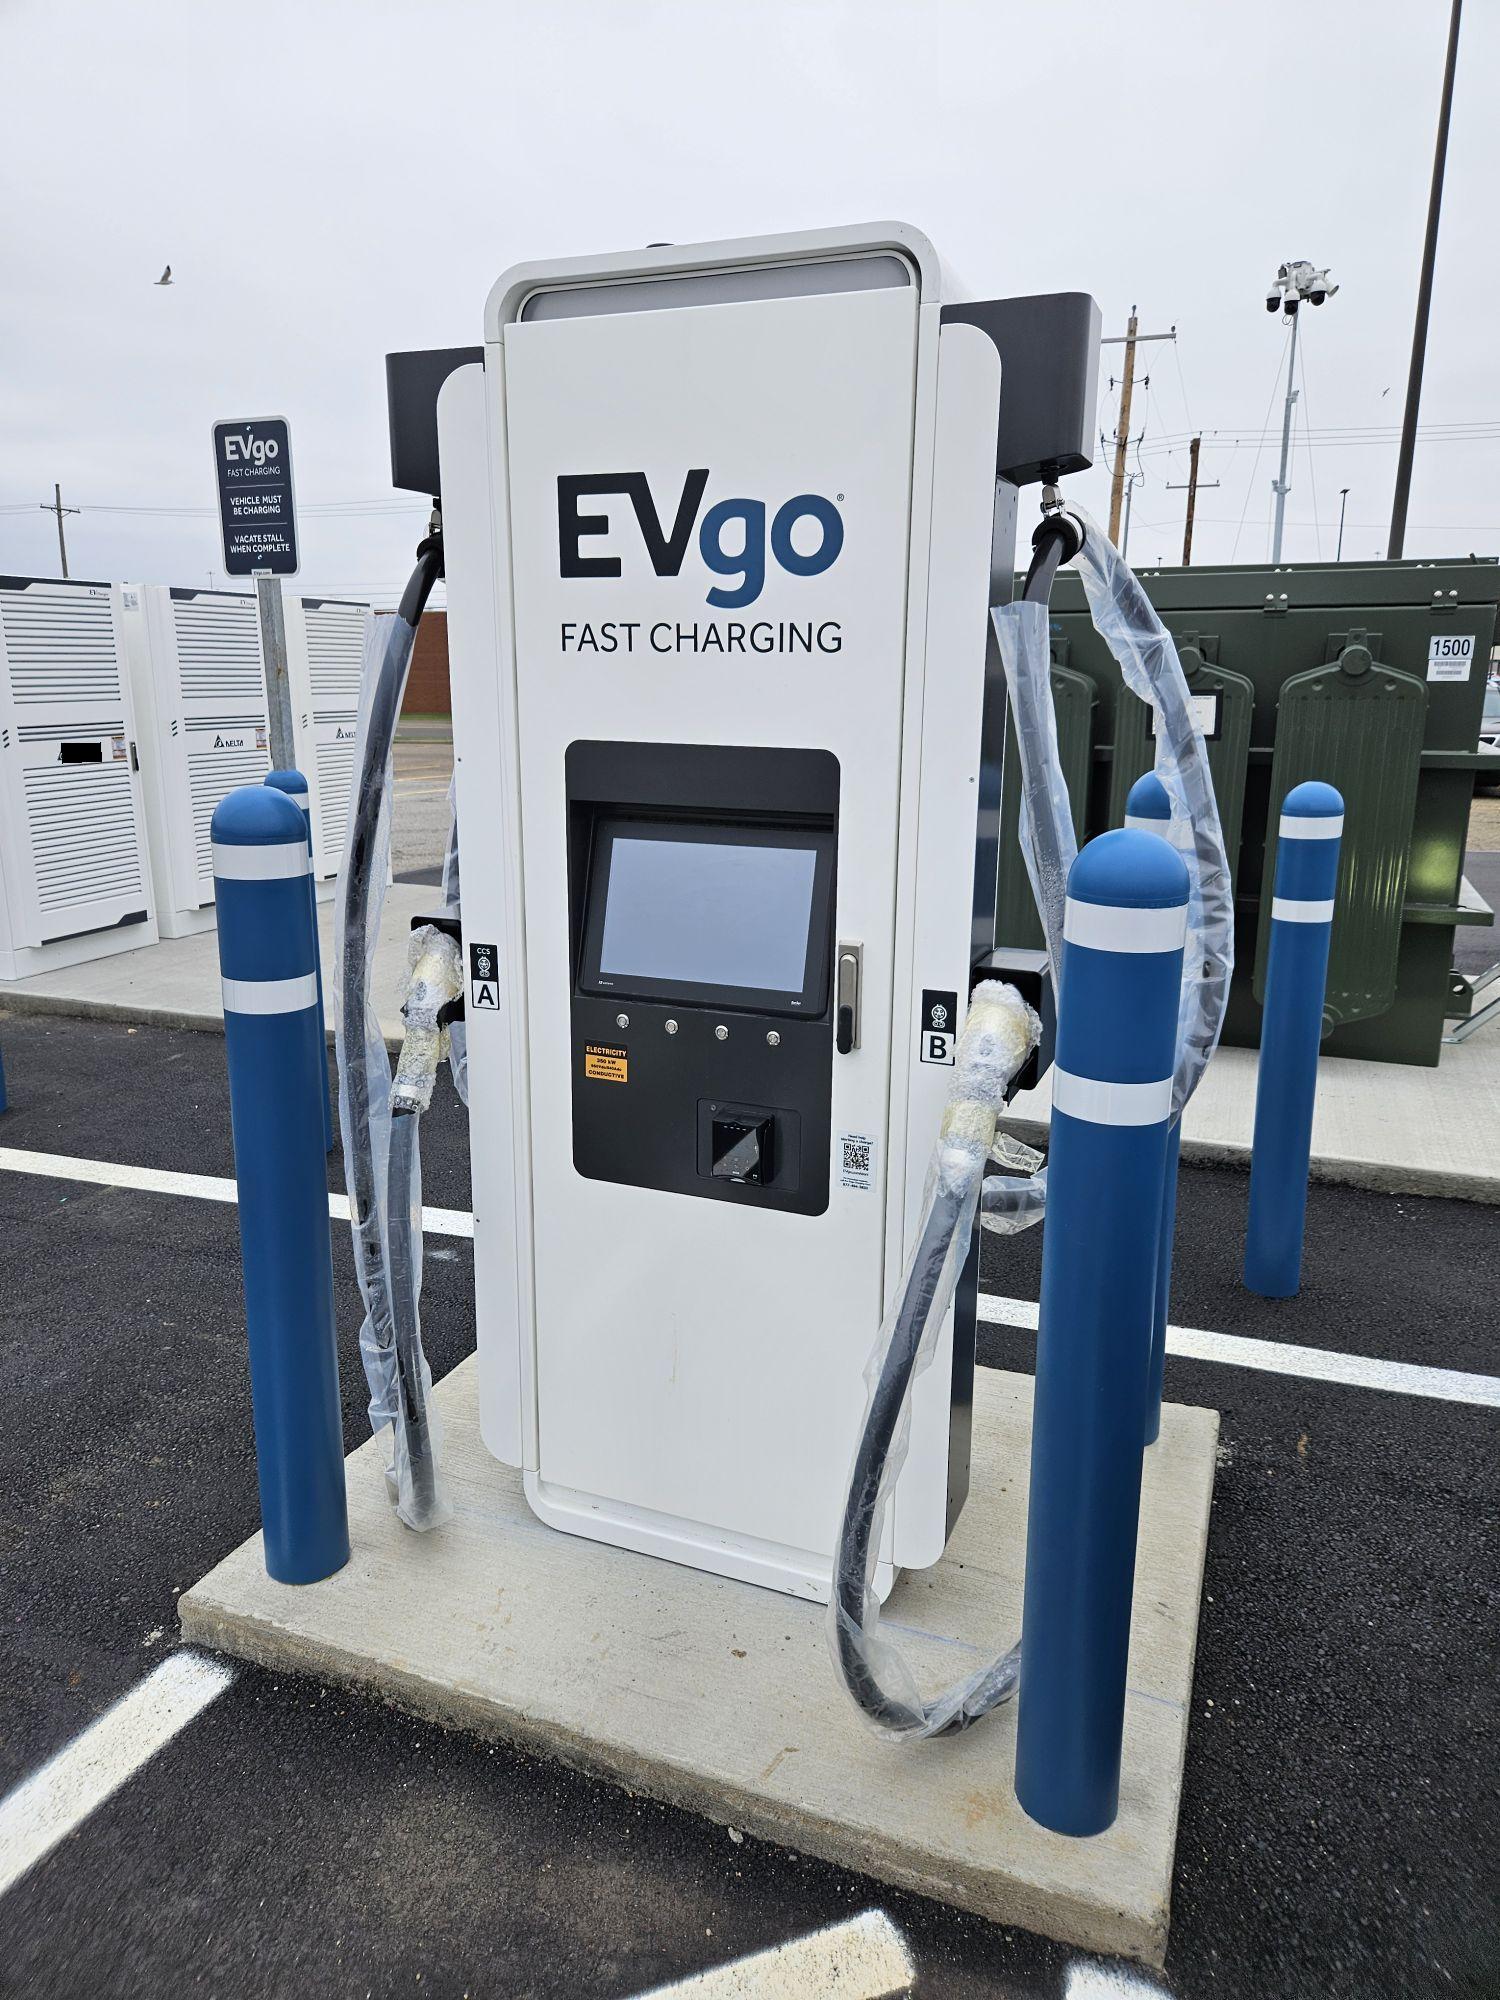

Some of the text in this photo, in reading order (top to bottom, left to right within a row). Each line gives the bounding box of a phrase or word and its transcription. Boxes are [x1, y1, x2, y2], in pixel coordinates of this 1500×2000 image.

[224, 434, 279, 466] EVgo
[227, 466, 281, 477] FAST CHARGING
[230, 494, 282, 506] VEHICLE MUST
[233, 505, 281, 515] BE CHARGING
[234, 533, 285, 543] VACATE STALL
[557, 468, 845, 609] EVgo
[230, 543, 291, 553] WHEN COMPLETE
[561, 621, 842, 653] FAST CHARGING
[1434, 638, 1471, 656] 1500
[476, 947, 491, 955] CCS
[477, 983, 495, 1006] A
[586, 1045, 627, 1057] ELECTRICITY
[929, 1034, 947, 1059] B
[588, 1069, 625, 1079] CONDUCTIVE
